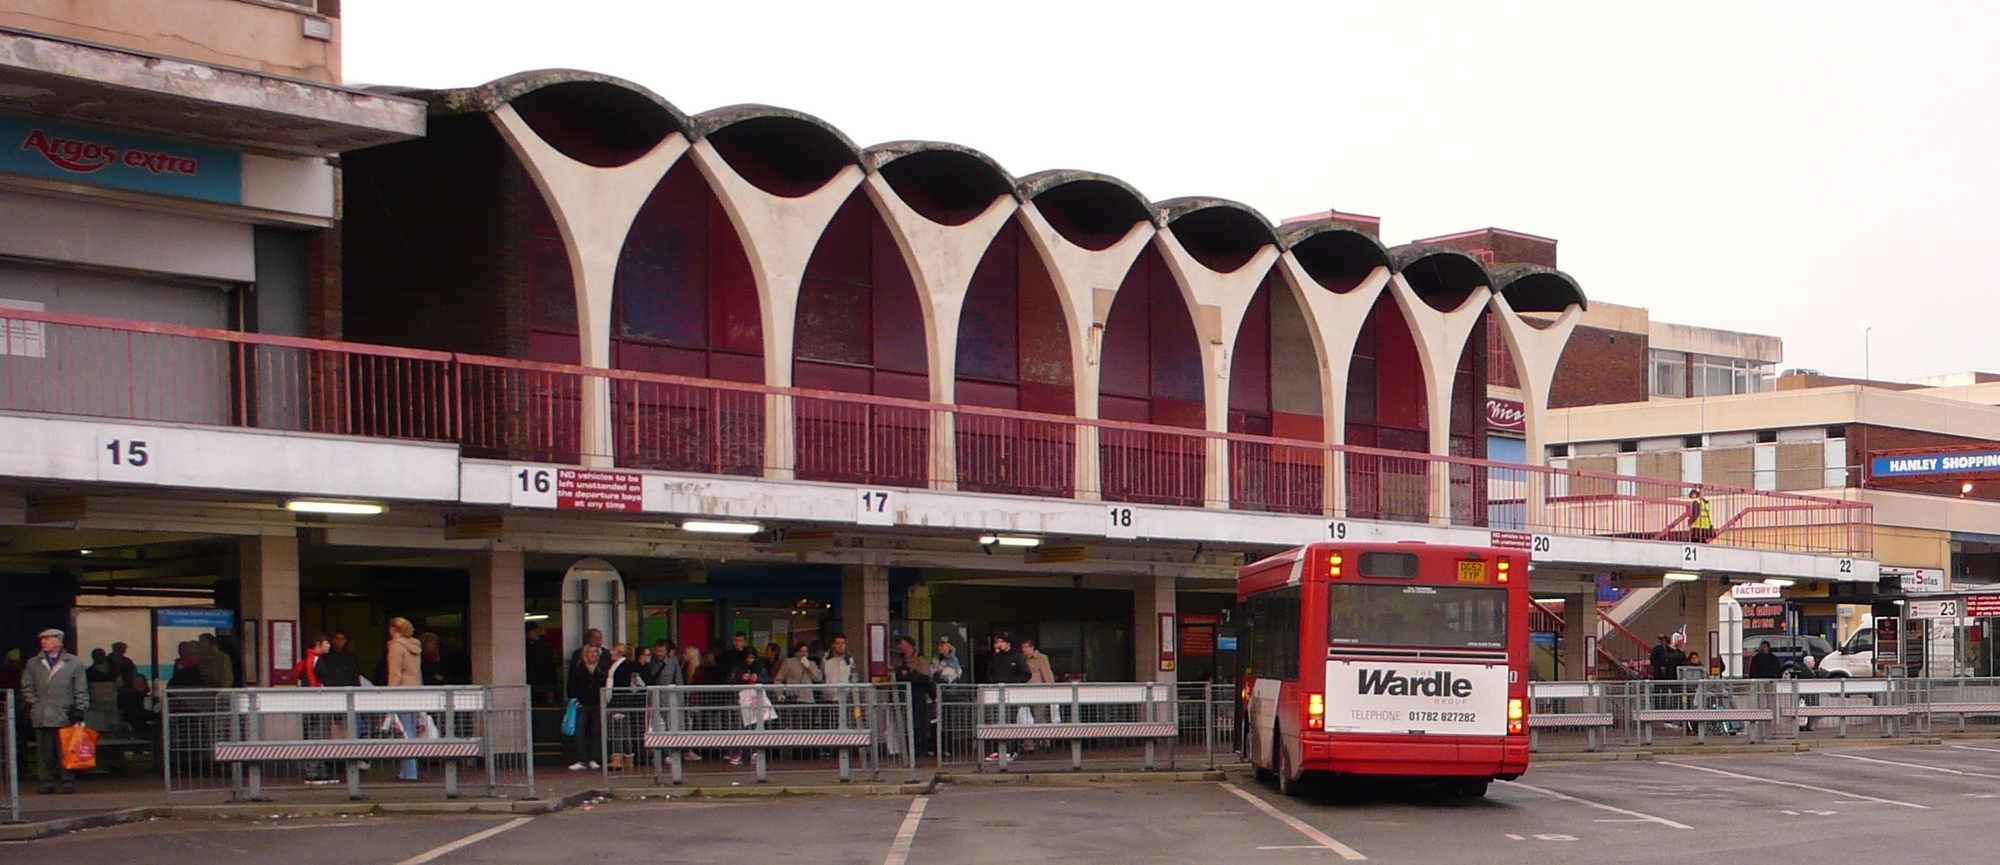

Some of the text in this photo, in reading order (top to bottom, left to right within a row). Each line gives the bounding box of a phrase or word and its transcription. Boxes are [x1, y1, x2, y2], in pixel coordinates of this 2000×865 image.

[21, 128, 198, 176] Argos extra
[107, 439, 149, 467] 15
[1890, 459, 1937, 472] HANLEY
[518, 469, 550, 493] 16
[560, 470, 639, 482] NO vehicles to be
[558, 480, 574, 488] left
[576, 481, 627, 491] unattended
[575, 490, 620, 500] departure
[621, 492, 642, 502] bays
[863, 491, 888, 512] 17
[1111, 508, 1131, 527] 18
[1328, 522, 1346, 539] 19
[1534, 536, 1550, 552] 20
[1685, 546, 1697, 561] 21
[1460, 562, 1483, 572] DG52
[1840, 559, 1852, 573] 22
[1463, 571, 1480, 580] TYP
[1736, 587, 1771, 595] FACTORY
[1940, 601, 1956, 615] 23
[1358, 669, 1473, 698] Wardle
[1408, 711, 1438, 722] 01782
[1441, 712, 1476, 723] 827282
